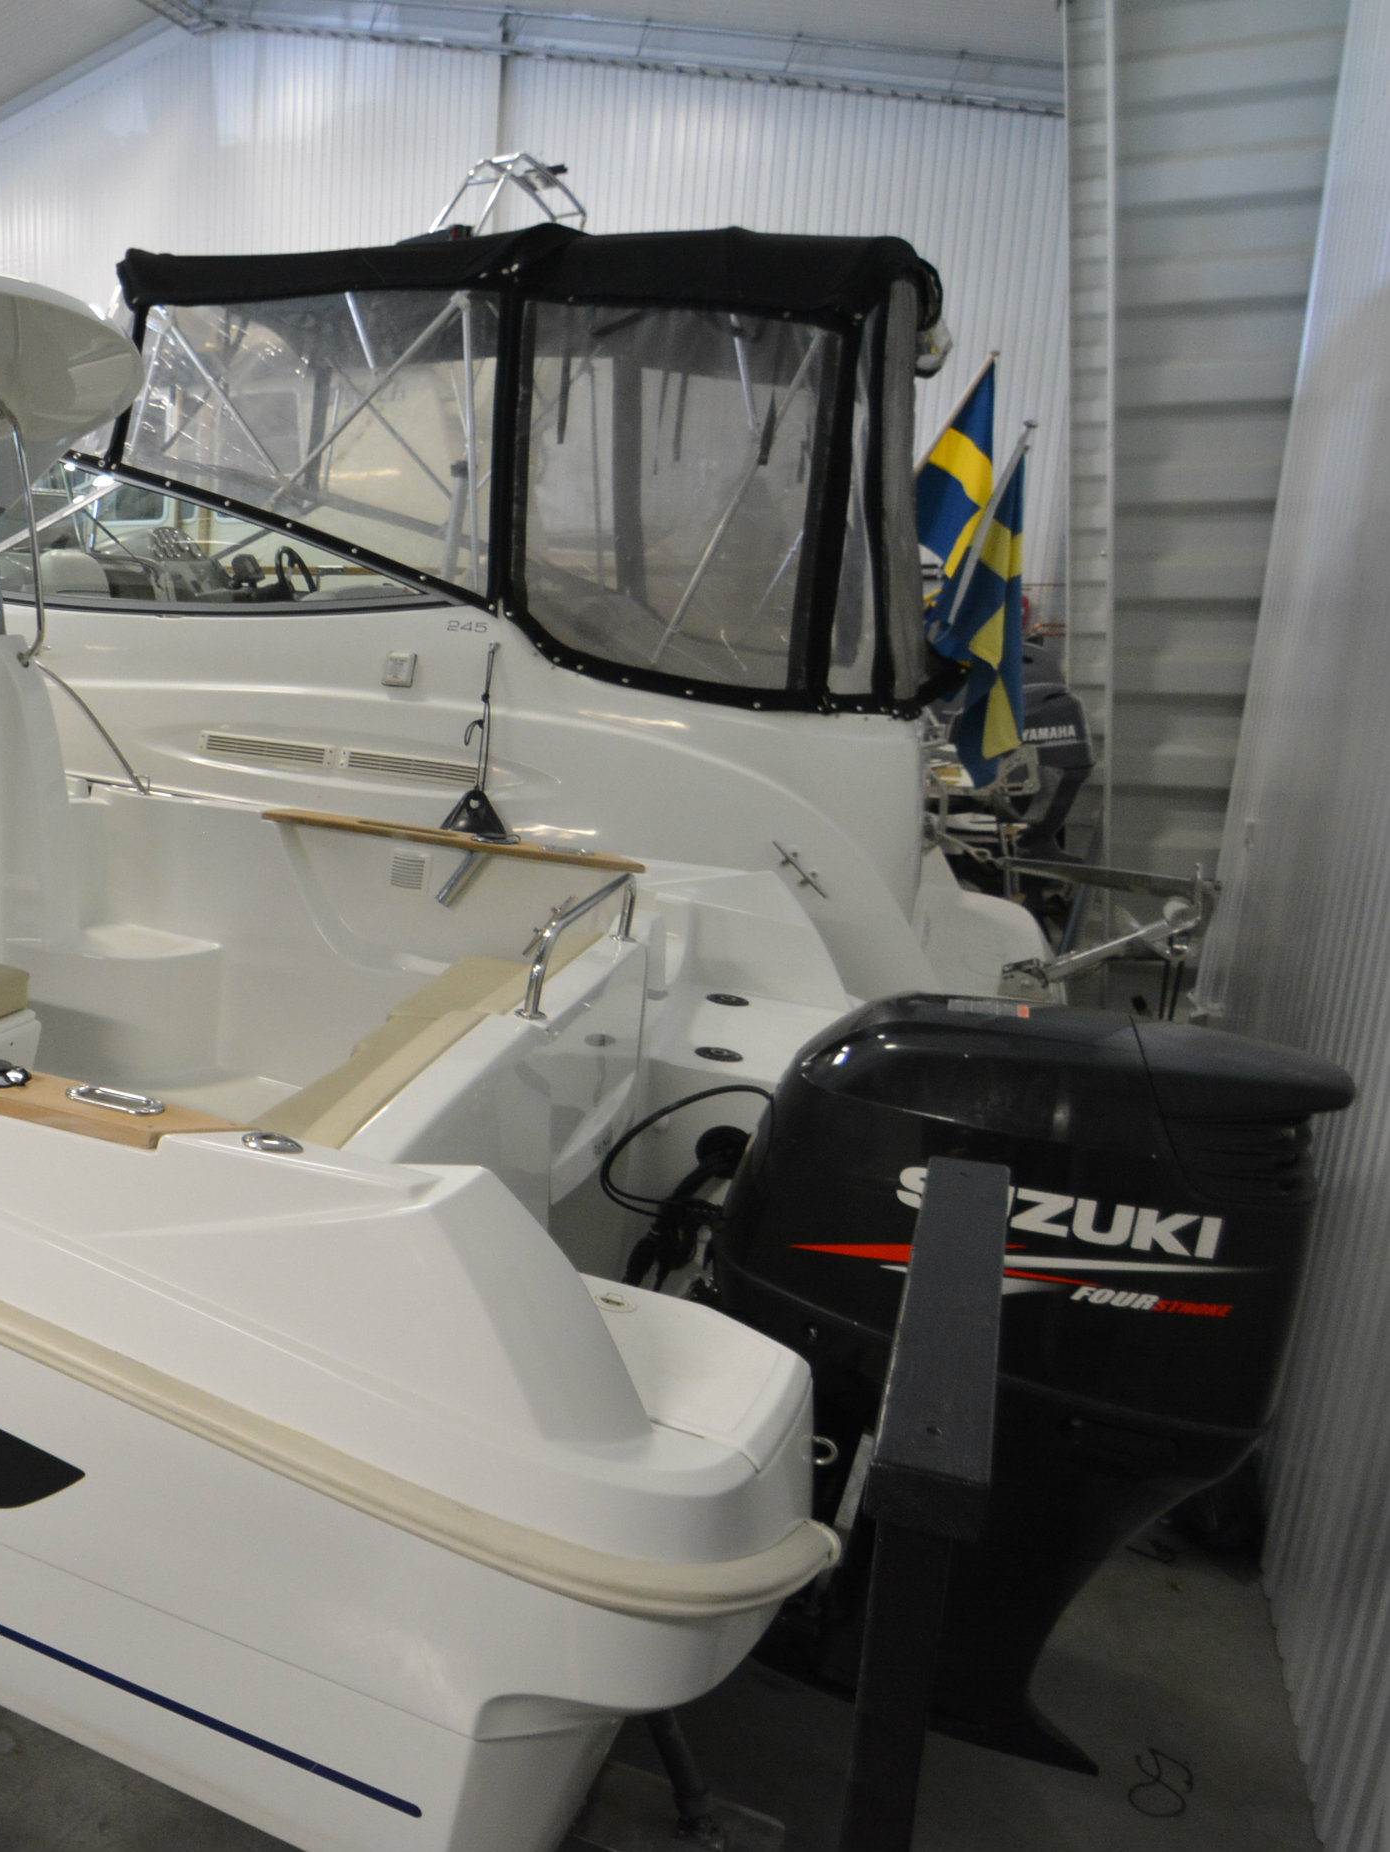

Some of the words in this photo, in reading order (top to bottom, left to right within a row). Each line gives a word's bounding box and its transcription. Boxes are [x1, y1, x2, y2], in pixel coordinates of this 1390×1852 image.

[446, 619, 488, 634] 245
[1022, 724, 1076, 742] YAMAHA
[896, 1166, 1223, 1260] SZUKI
